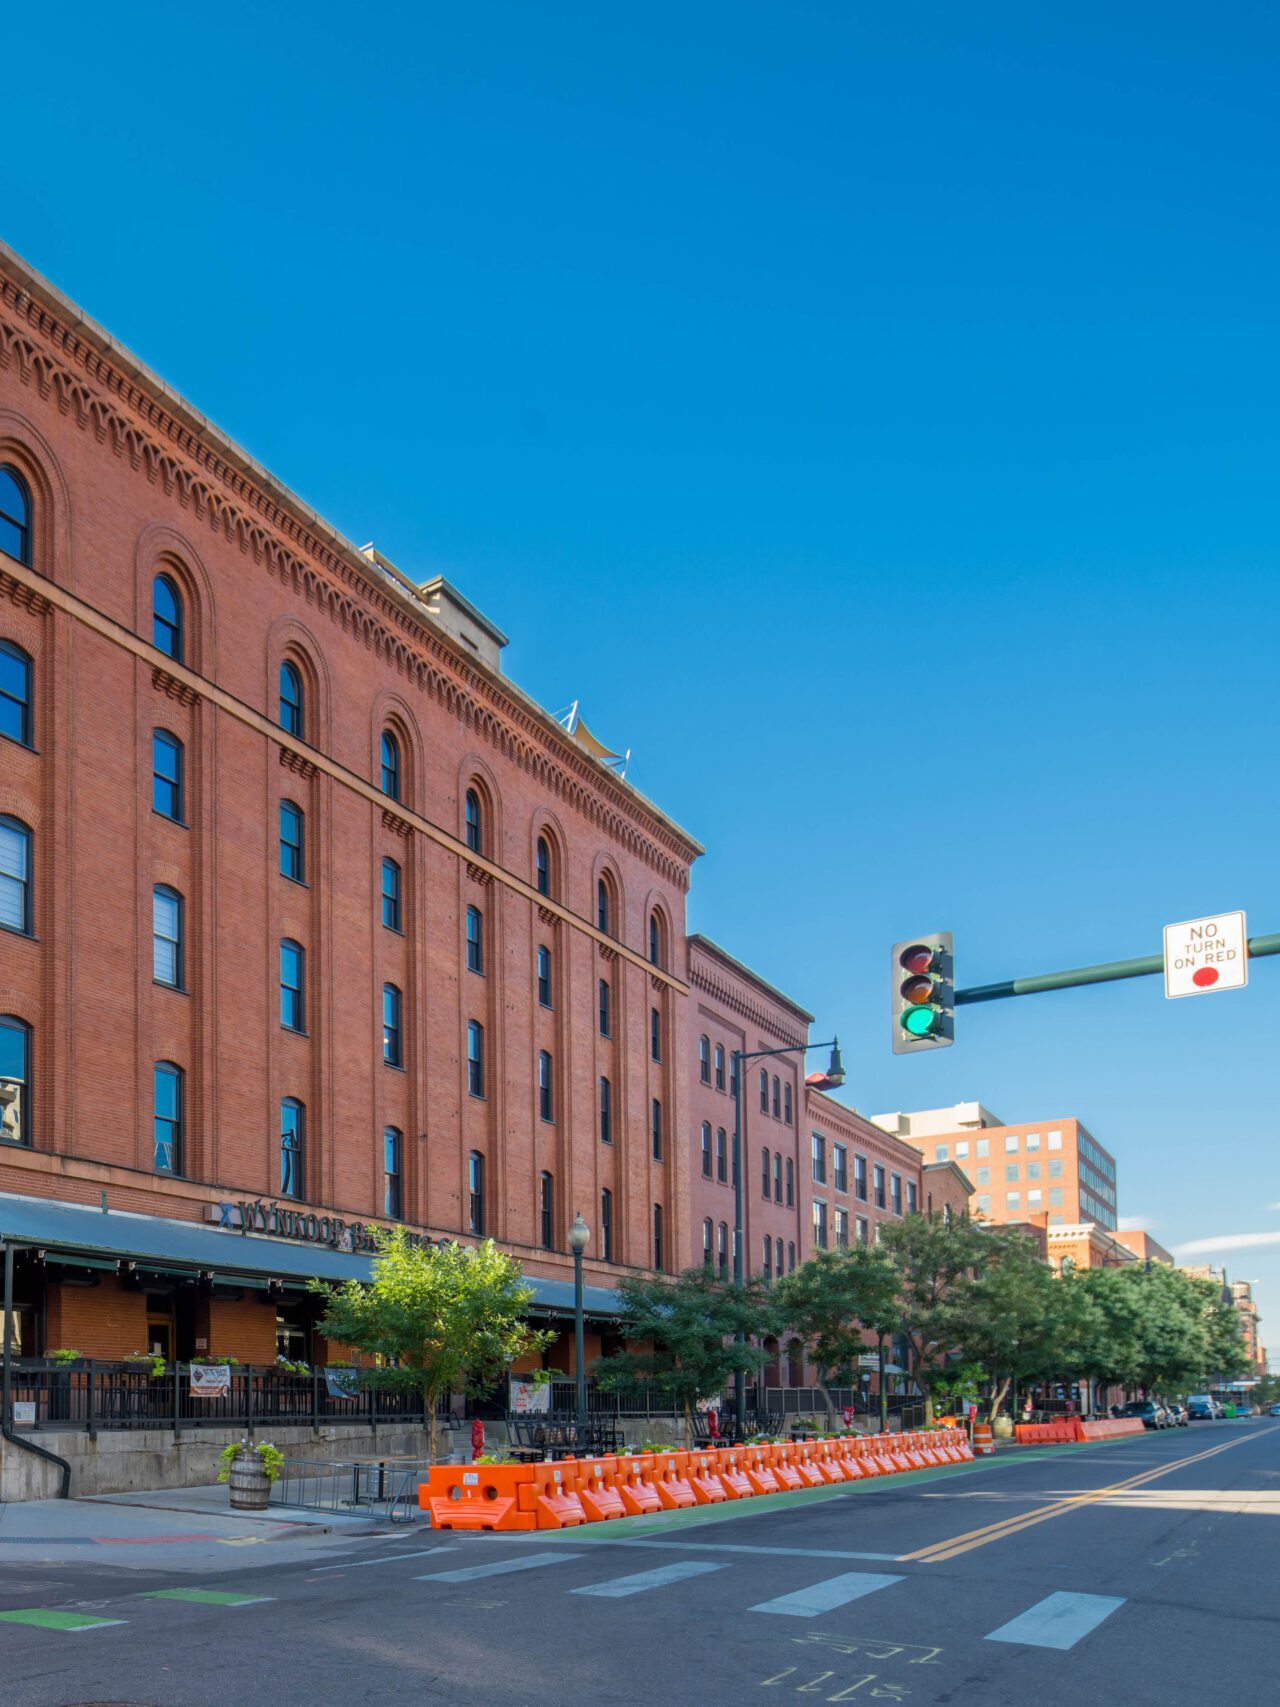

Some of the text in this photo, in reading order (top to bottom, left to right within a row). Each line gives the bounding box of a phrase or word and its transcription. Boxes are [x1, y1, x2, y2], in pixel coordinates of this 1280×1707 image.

[1190, 923, 1217, 940] NO
[1184, 938, 1225, 954] TURN
[1174, 949, 1236, 969] ON RED
[238, 1198, 346, 1247] WYNKOOP
